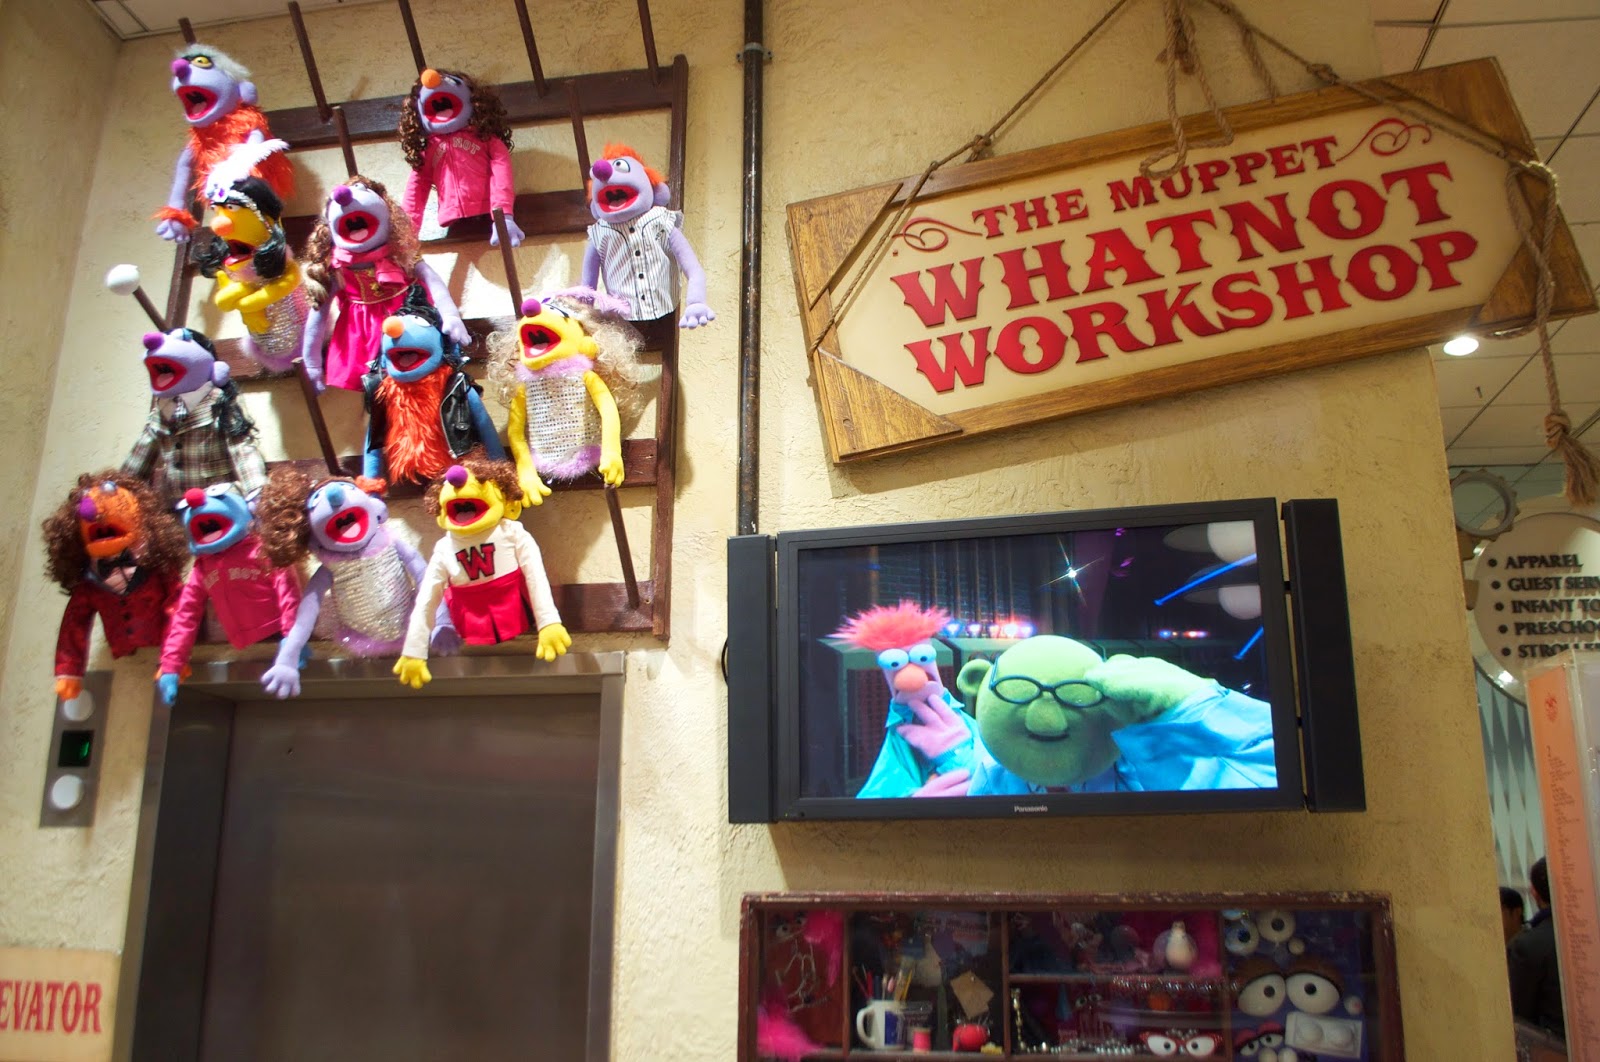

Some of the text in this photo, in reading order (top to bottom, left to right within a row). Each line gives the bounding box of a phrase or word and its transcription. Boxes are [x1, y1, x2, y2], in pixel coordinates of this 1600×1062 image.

[971, 136, 1339, 239] THE MUPPET
[890, 161, 1453, 327] WHATNOT
[904, 231, 1479, 393] WORKSHOP
[456, 543, 495, 581] W
[1506, 554, 1583, 569] APPAREL
[1508, 577, 1562, 591] GUEST
[1512, 599, 1573, 613] INFANT
